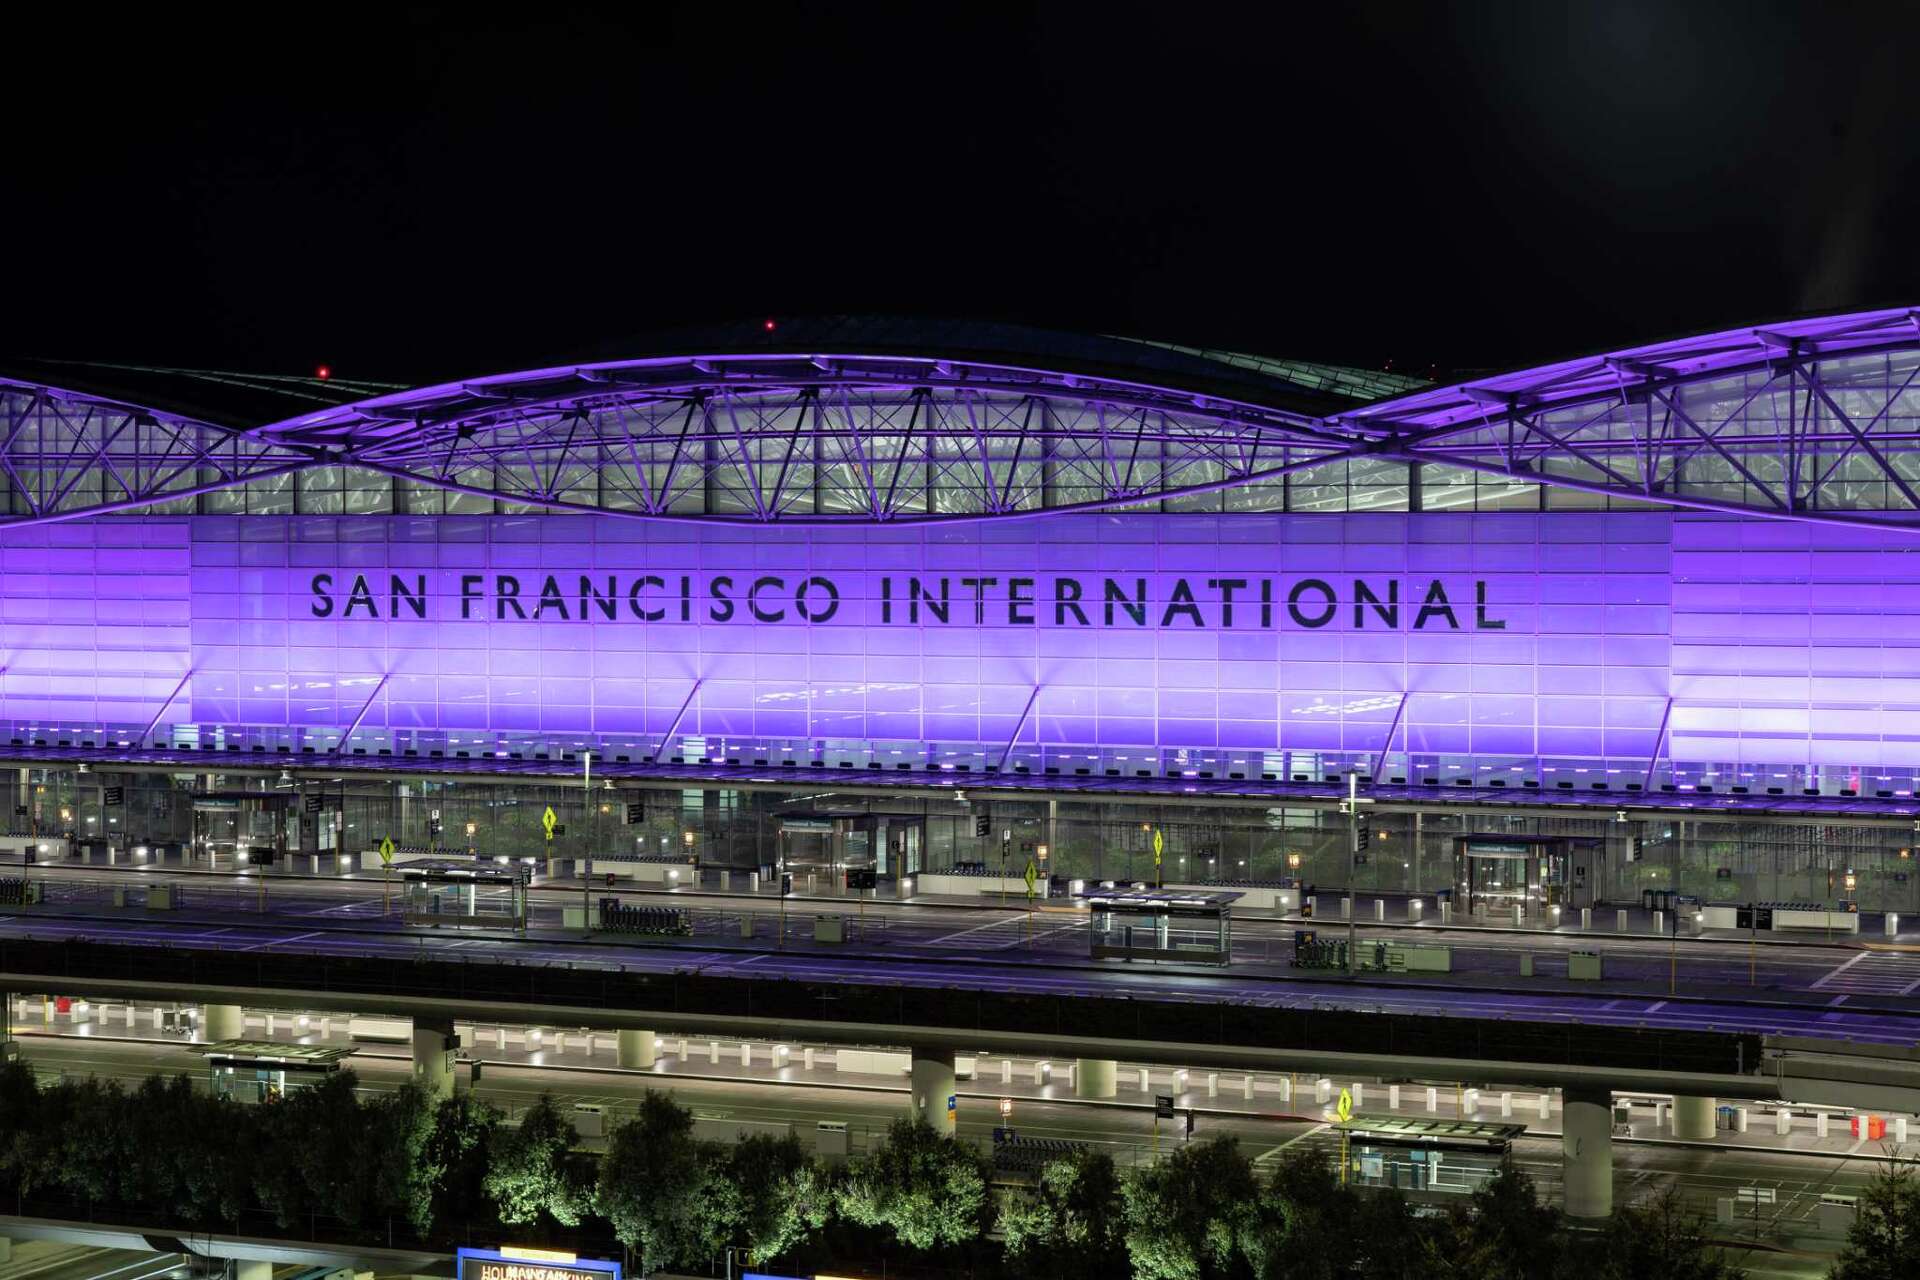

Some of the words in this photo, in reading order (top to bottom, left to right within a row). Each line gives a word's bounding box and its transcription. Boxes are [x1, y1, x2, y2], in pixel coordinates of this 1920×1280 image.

[310, 573, 427, 618] SAN
[461, 575, 839, 623] FRANCISCO
[881, 577, 1505, 629] INTERNATIONAL
